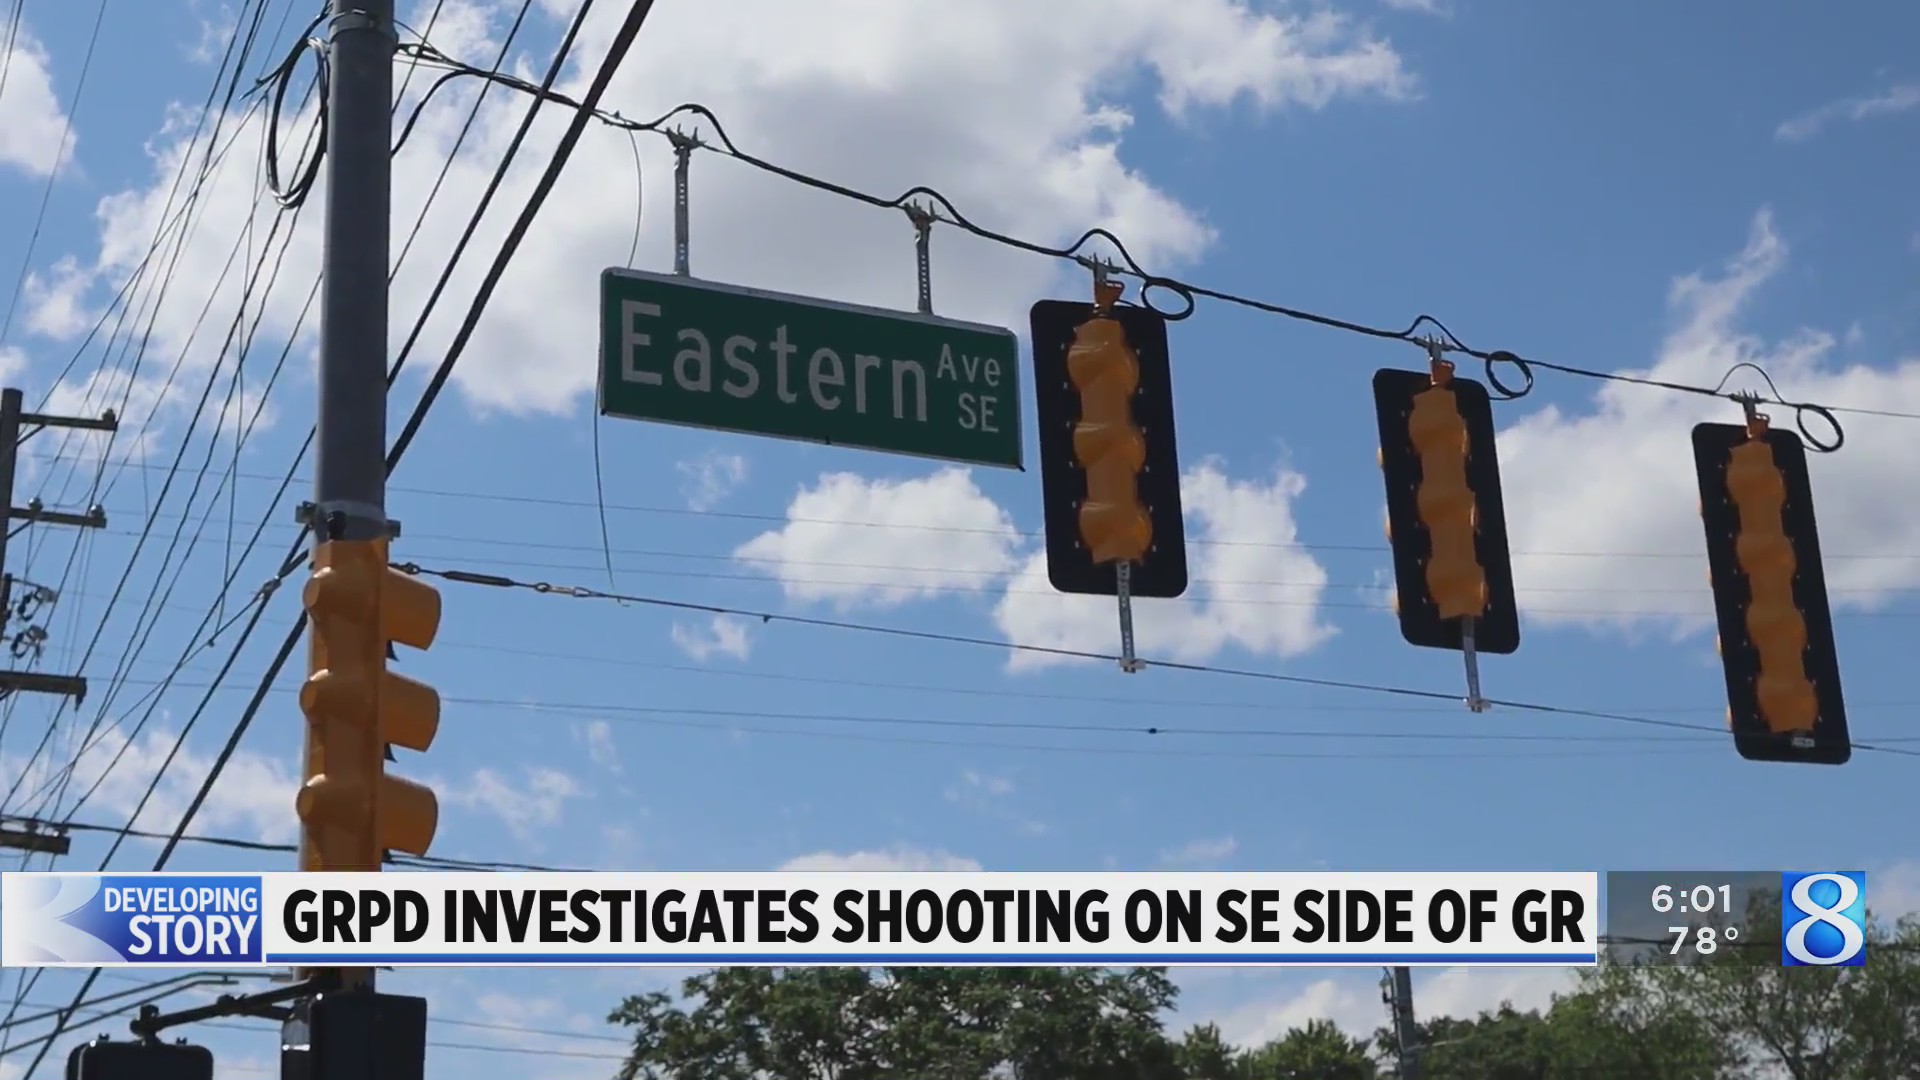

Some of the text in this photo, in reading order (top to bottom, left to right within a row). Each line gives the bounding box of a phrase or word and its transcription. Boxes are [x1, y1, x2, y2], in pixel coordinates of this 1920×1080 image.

[621, 298, 1001, 422] Eastern Ave
[958, 392, 1000, 433] SE
